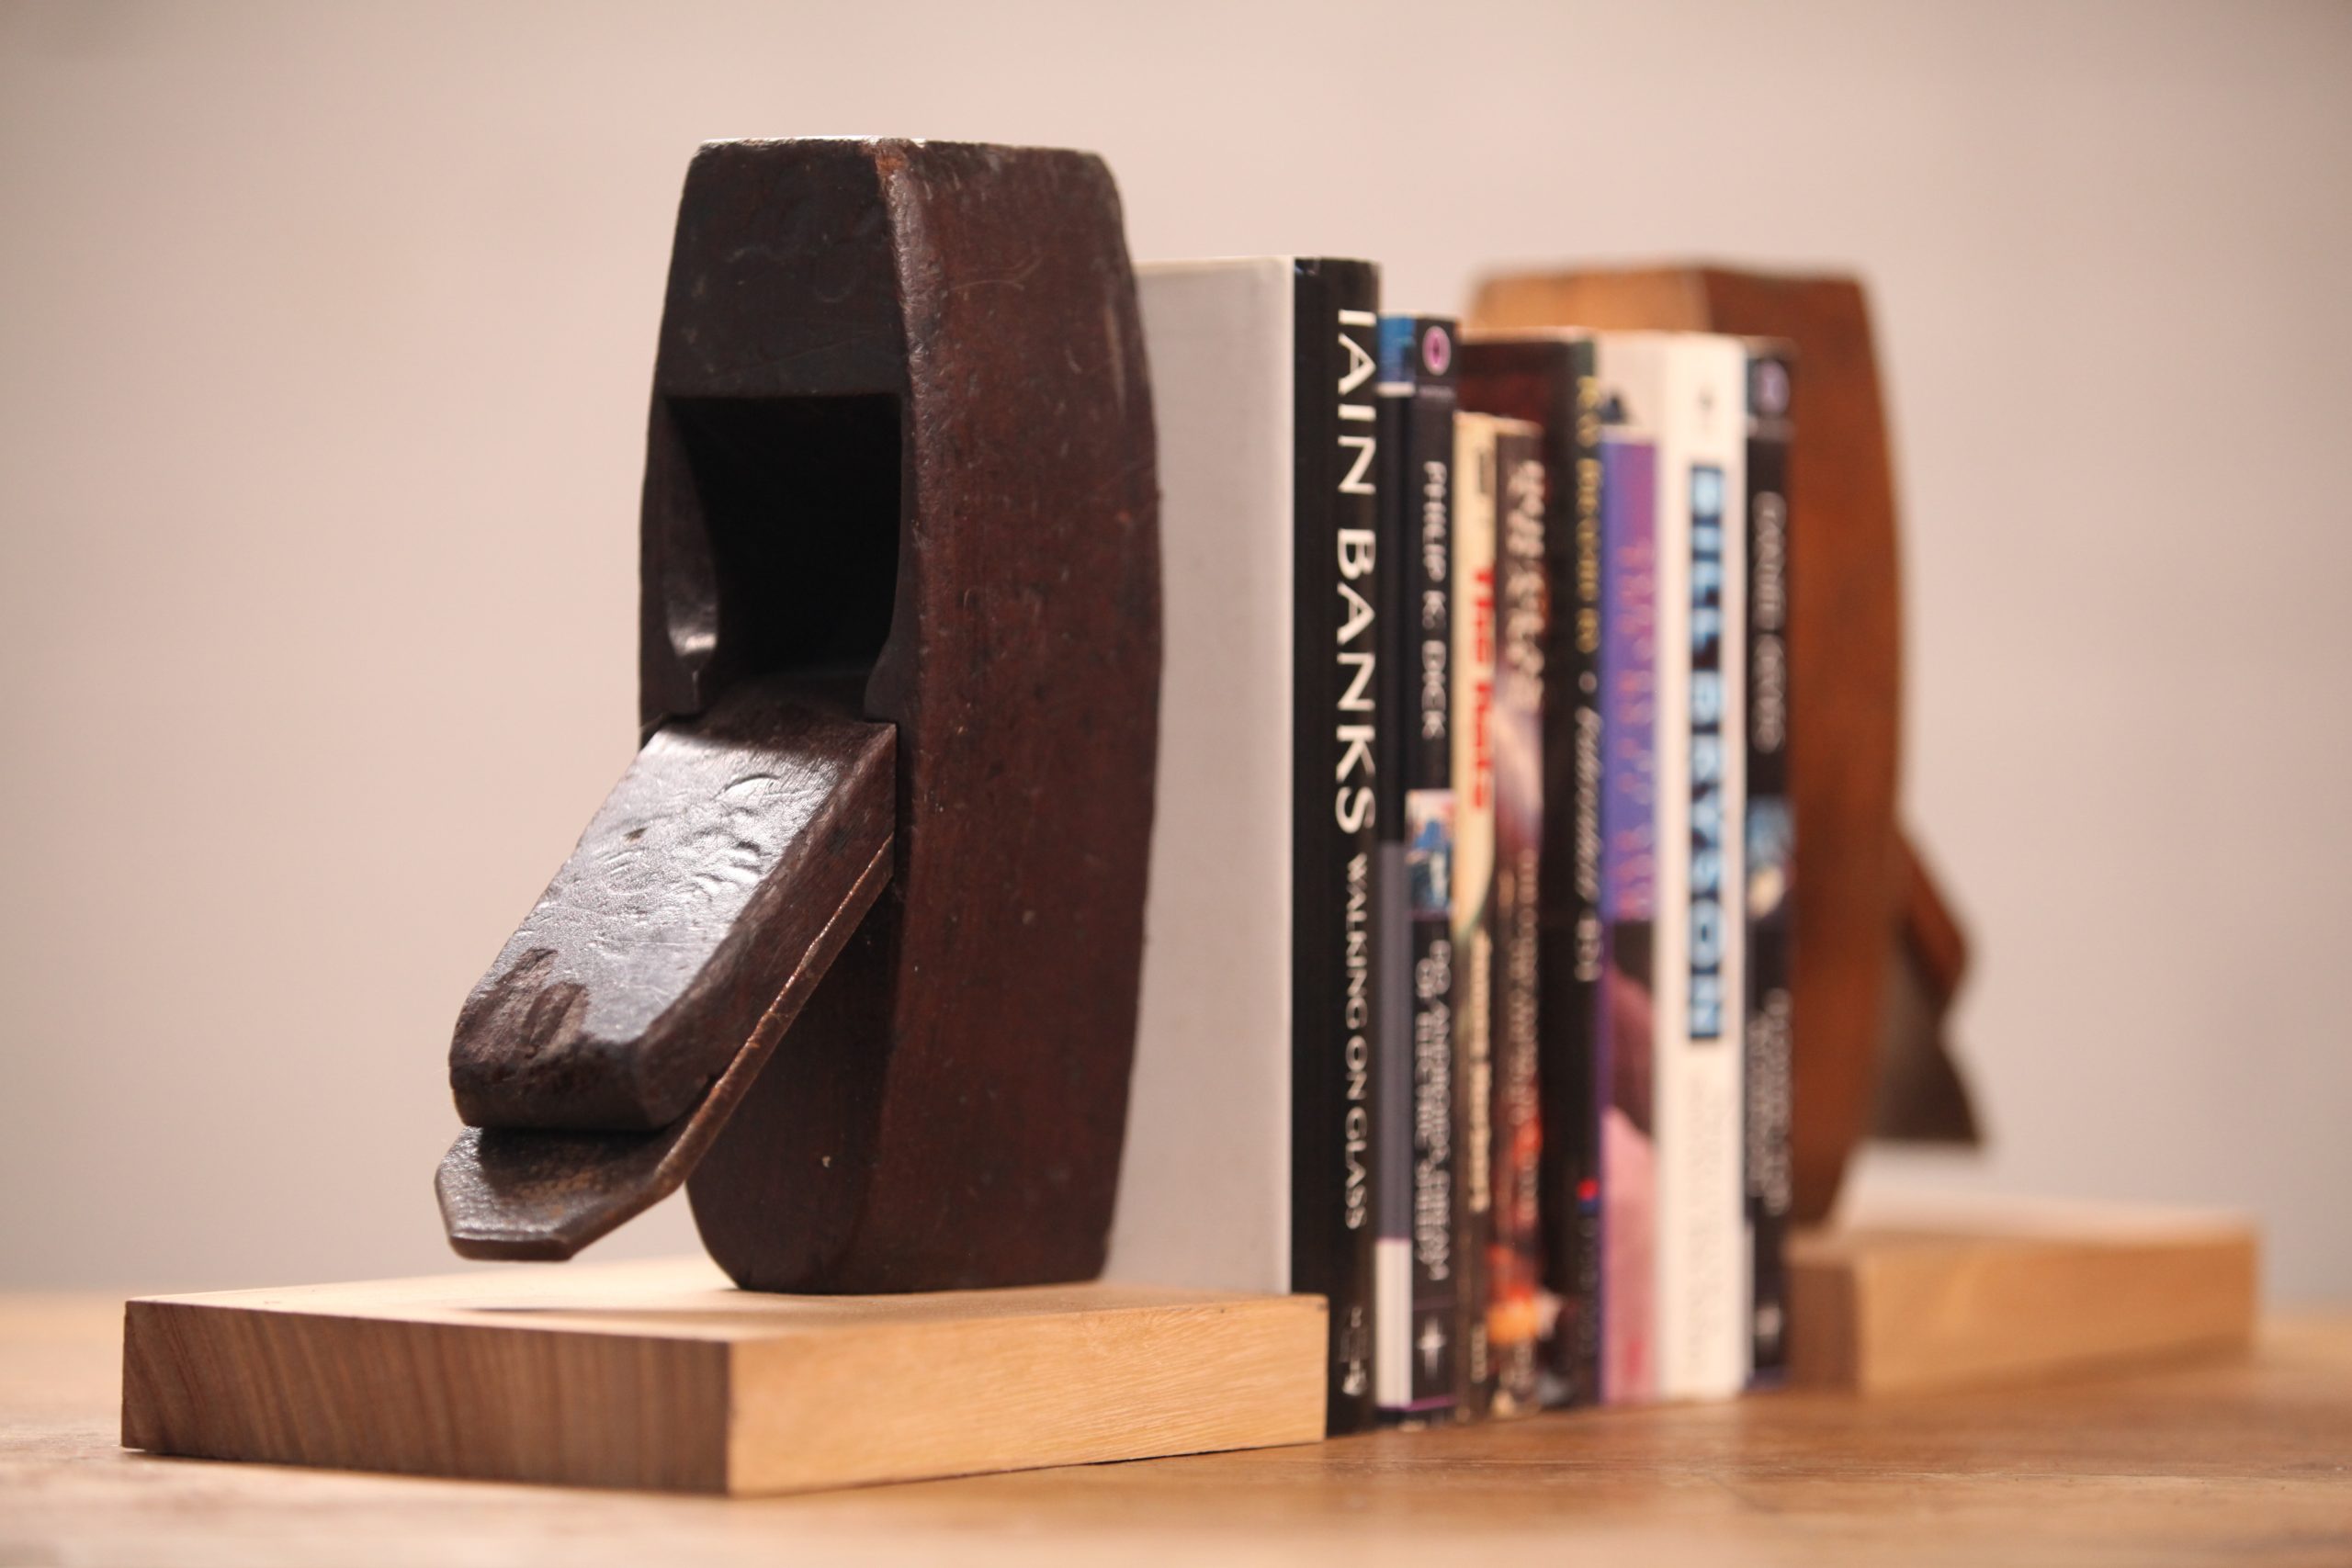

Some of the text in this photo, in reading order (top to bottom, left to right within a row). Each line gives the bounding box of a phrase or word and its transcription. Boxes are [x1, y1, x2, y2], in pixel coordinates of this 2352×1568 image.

[1336, 310, 1376, 834] IAIN BANKS
[1422, 461, 1447, 581] PHILIP
[1422, 640, 1447, 739] DICK
[1690, 469, 1725, 1037] BILL BRYSON
[1345, 852, 1368, 1229] WALKING ON GLASS
